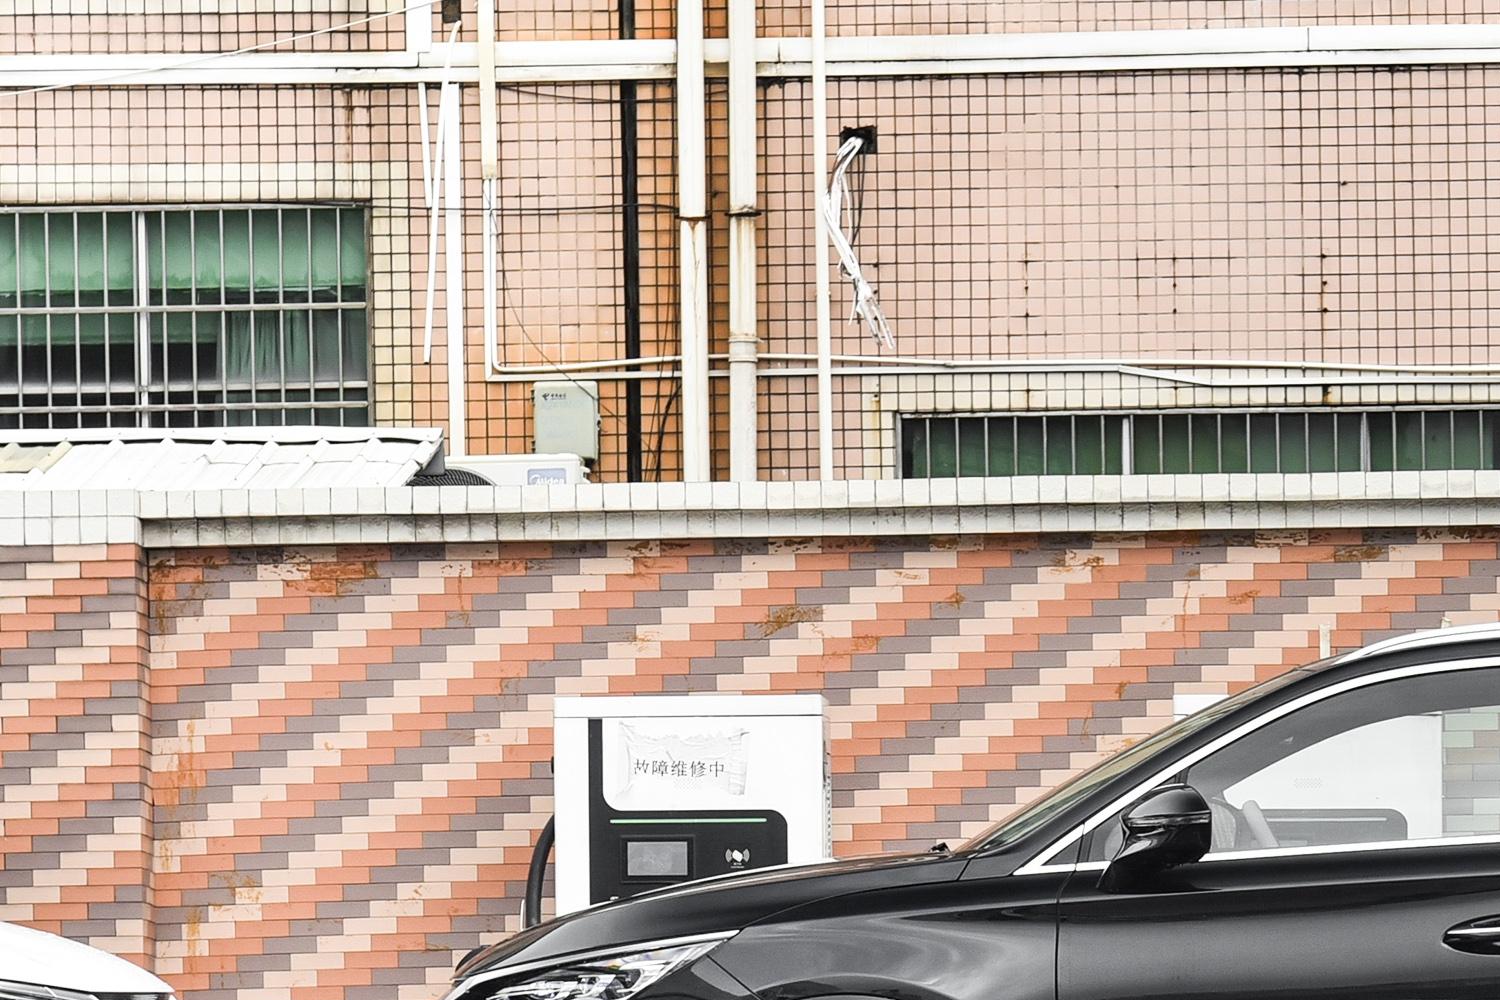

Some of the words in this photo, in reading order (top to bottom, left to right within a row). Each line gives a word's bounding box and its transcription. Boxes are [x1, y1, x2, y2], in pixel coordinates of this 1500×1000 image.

[634, 758, 725, 777] 故障维修中
